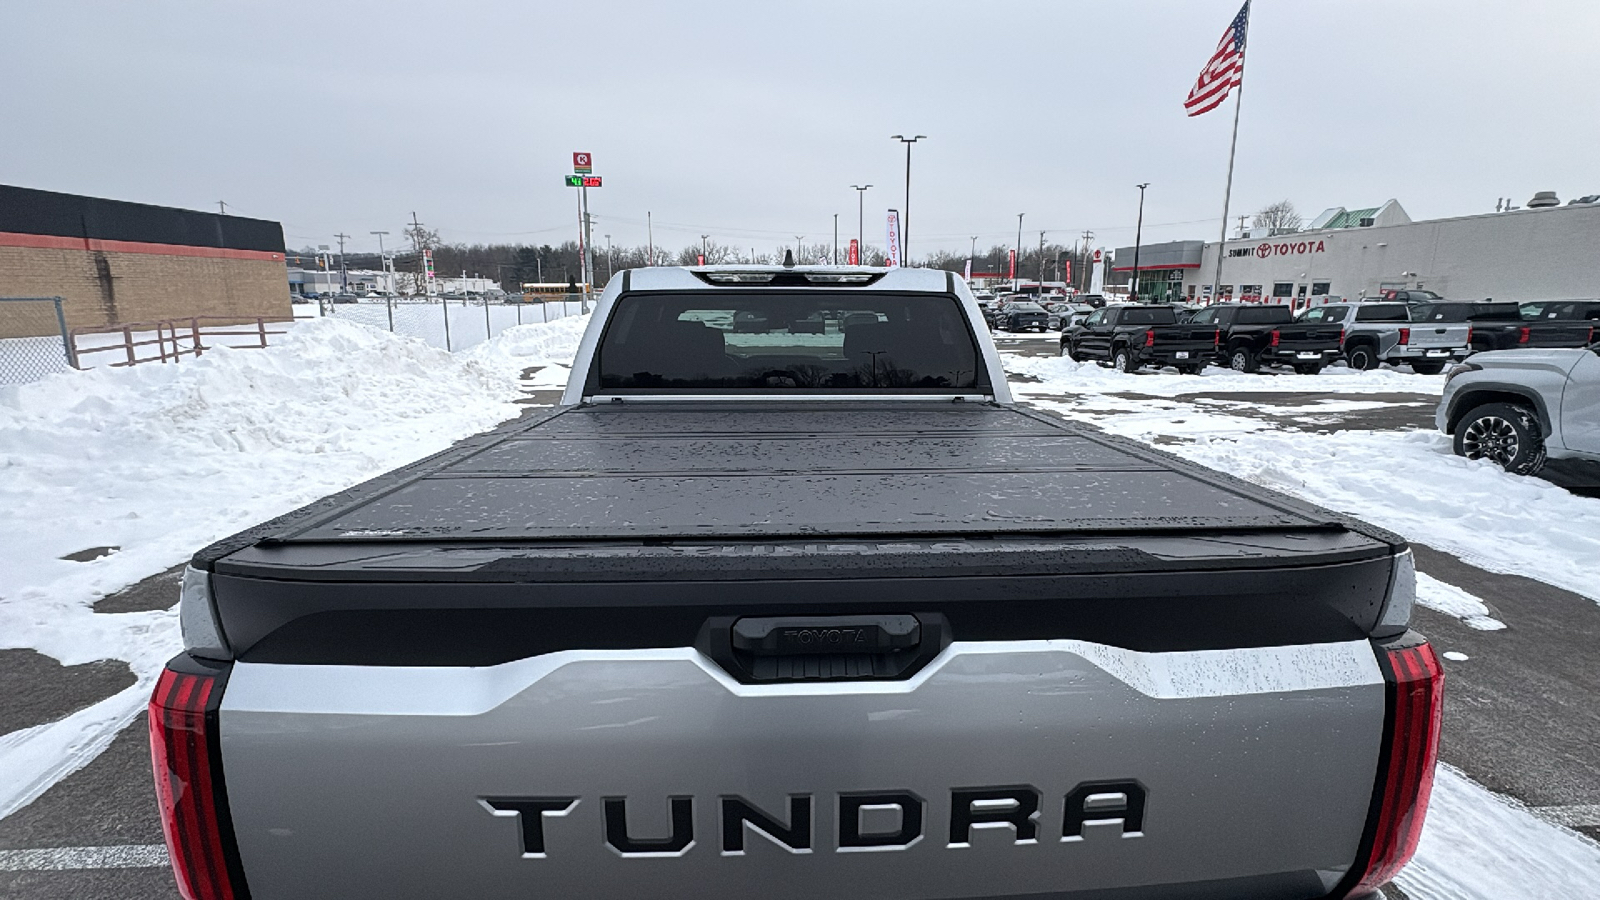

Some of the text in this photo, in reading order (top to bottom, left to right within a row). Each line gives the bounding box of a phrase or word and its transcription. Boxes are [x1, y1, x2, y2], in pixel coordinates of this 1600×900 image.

[889, 224, 897, 266] TOYOTA
[1228, 240, 1325, 258] SUMMIT TOYOTA
[784, 628, 866, 644] TOYOTA
[477, 779, 1149, 858] TUNDRA
